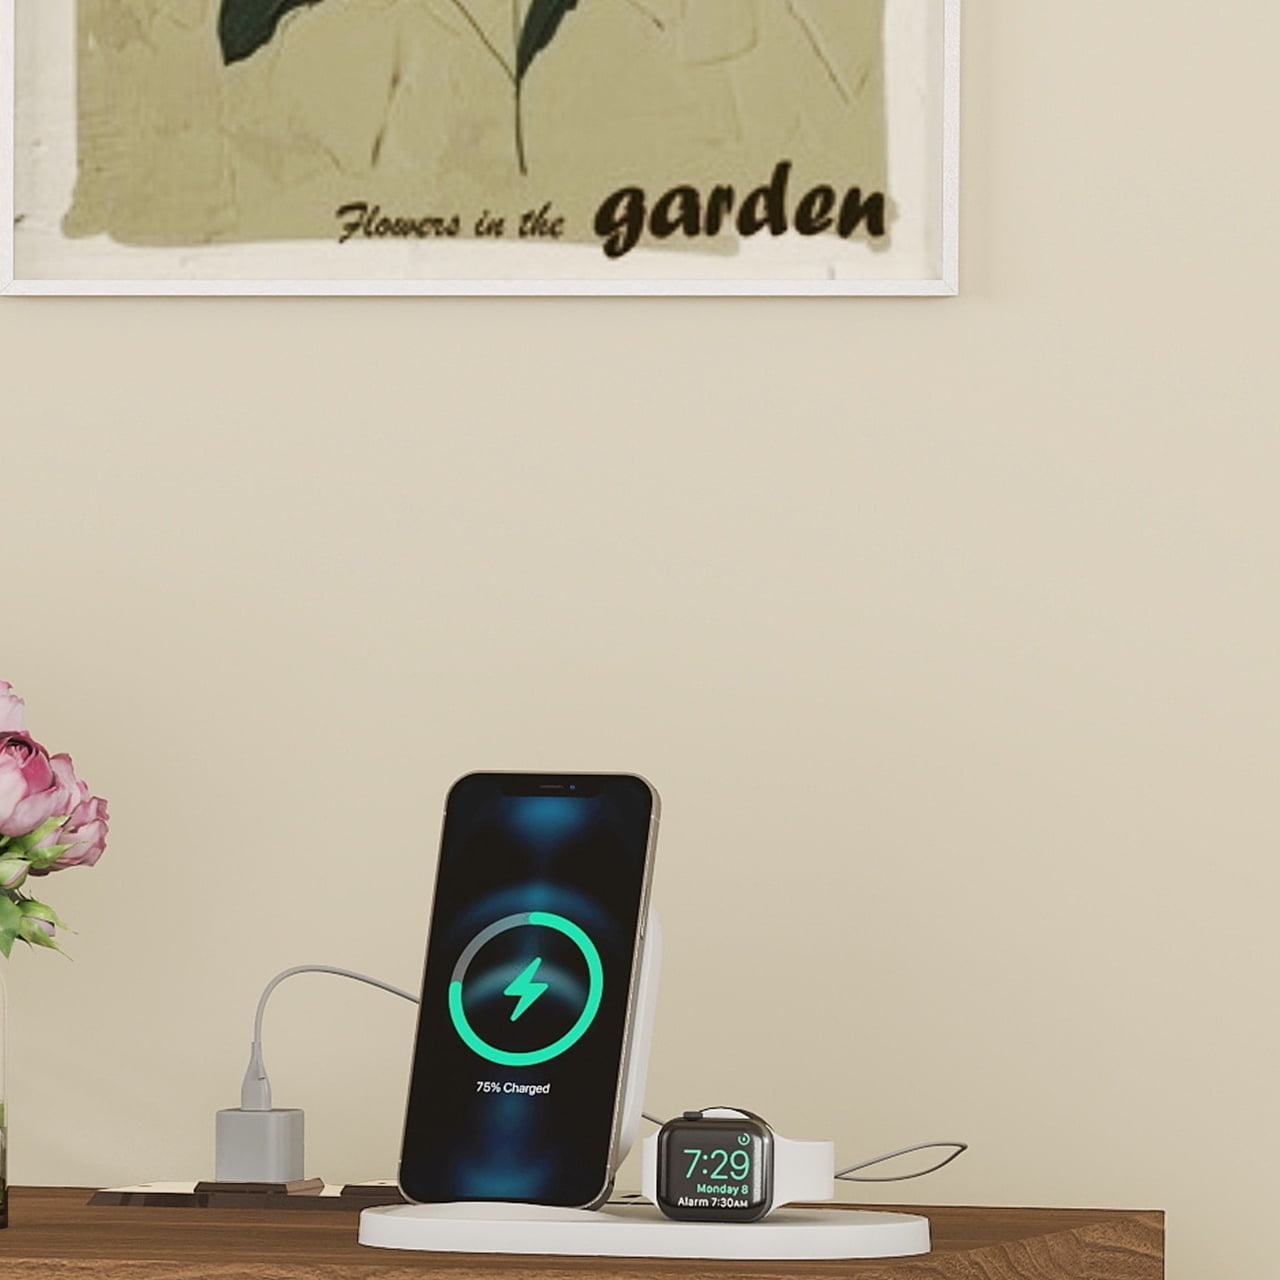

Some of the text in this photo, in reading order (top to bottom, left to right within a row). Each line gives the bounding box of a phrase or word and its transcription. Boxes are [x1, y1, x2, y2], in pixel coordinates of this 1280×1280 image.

[334, 160, 887, 259] Flowers in the garden
[476, 1081, 551, 1096] 75% Charged
[683, 1149, 750, 1180] 7:29
[696, 1183, 749, 1196] Monday 8
[677, 1197, 749, 1209] Alarm 7:30AM
